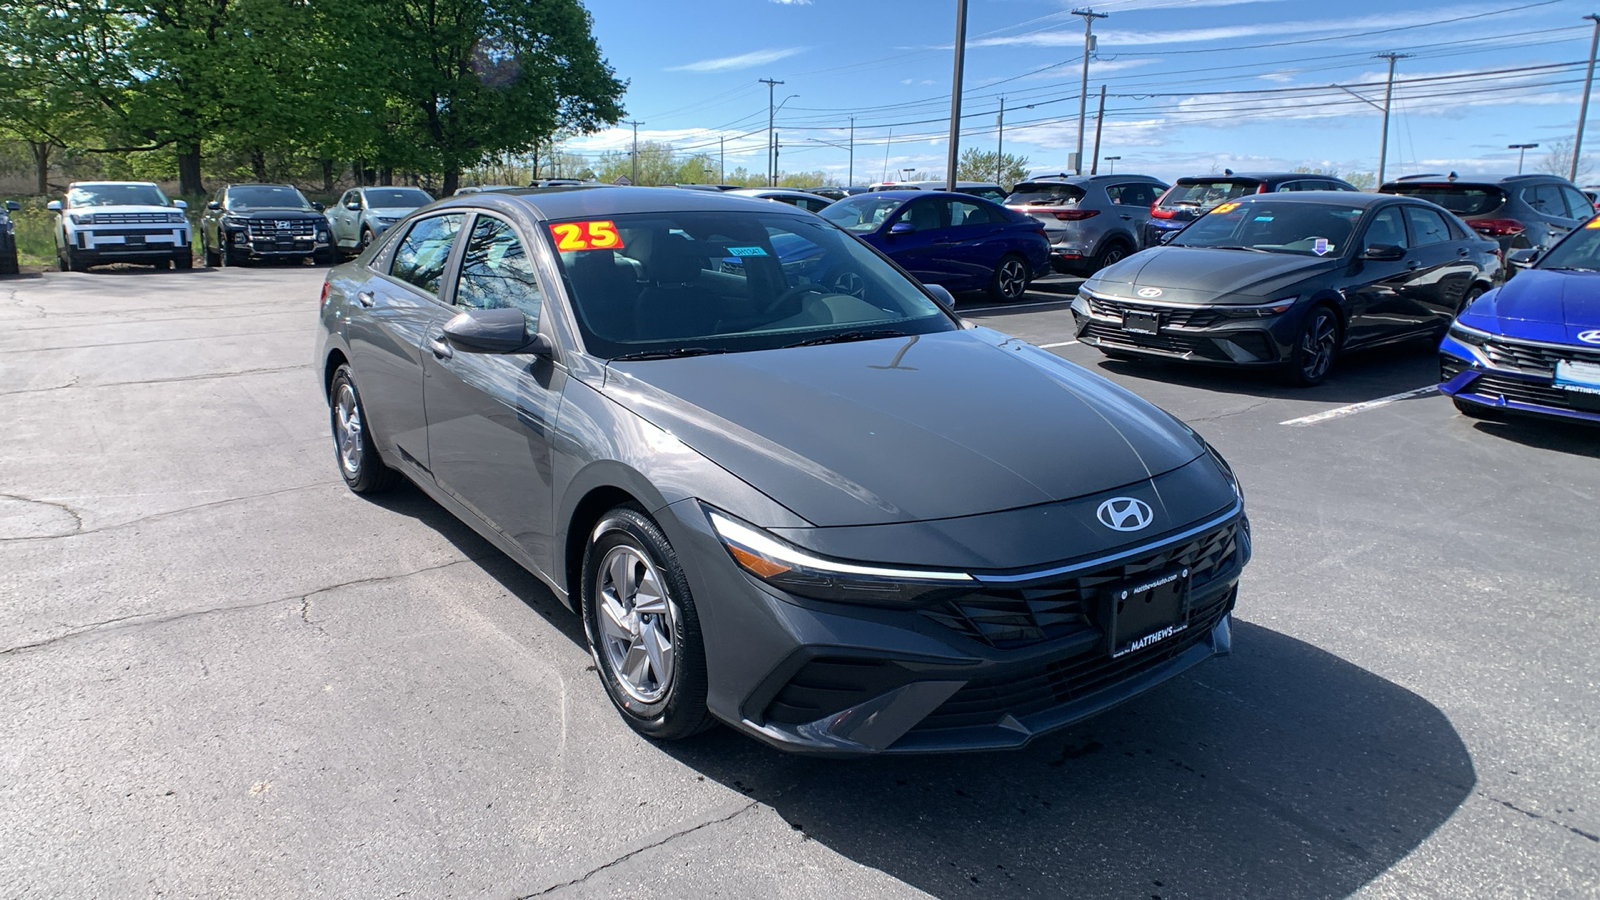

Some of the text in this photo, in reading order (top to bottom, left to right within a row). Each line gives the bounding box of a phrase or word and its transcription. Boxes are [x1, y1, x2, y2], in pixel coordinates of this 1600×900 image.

[553, 221, 618, 250] 25
[1133, 574, 1178, 594] MatthewsAuto.com
[1131, 626, 1173, 652] MATTHEWS
